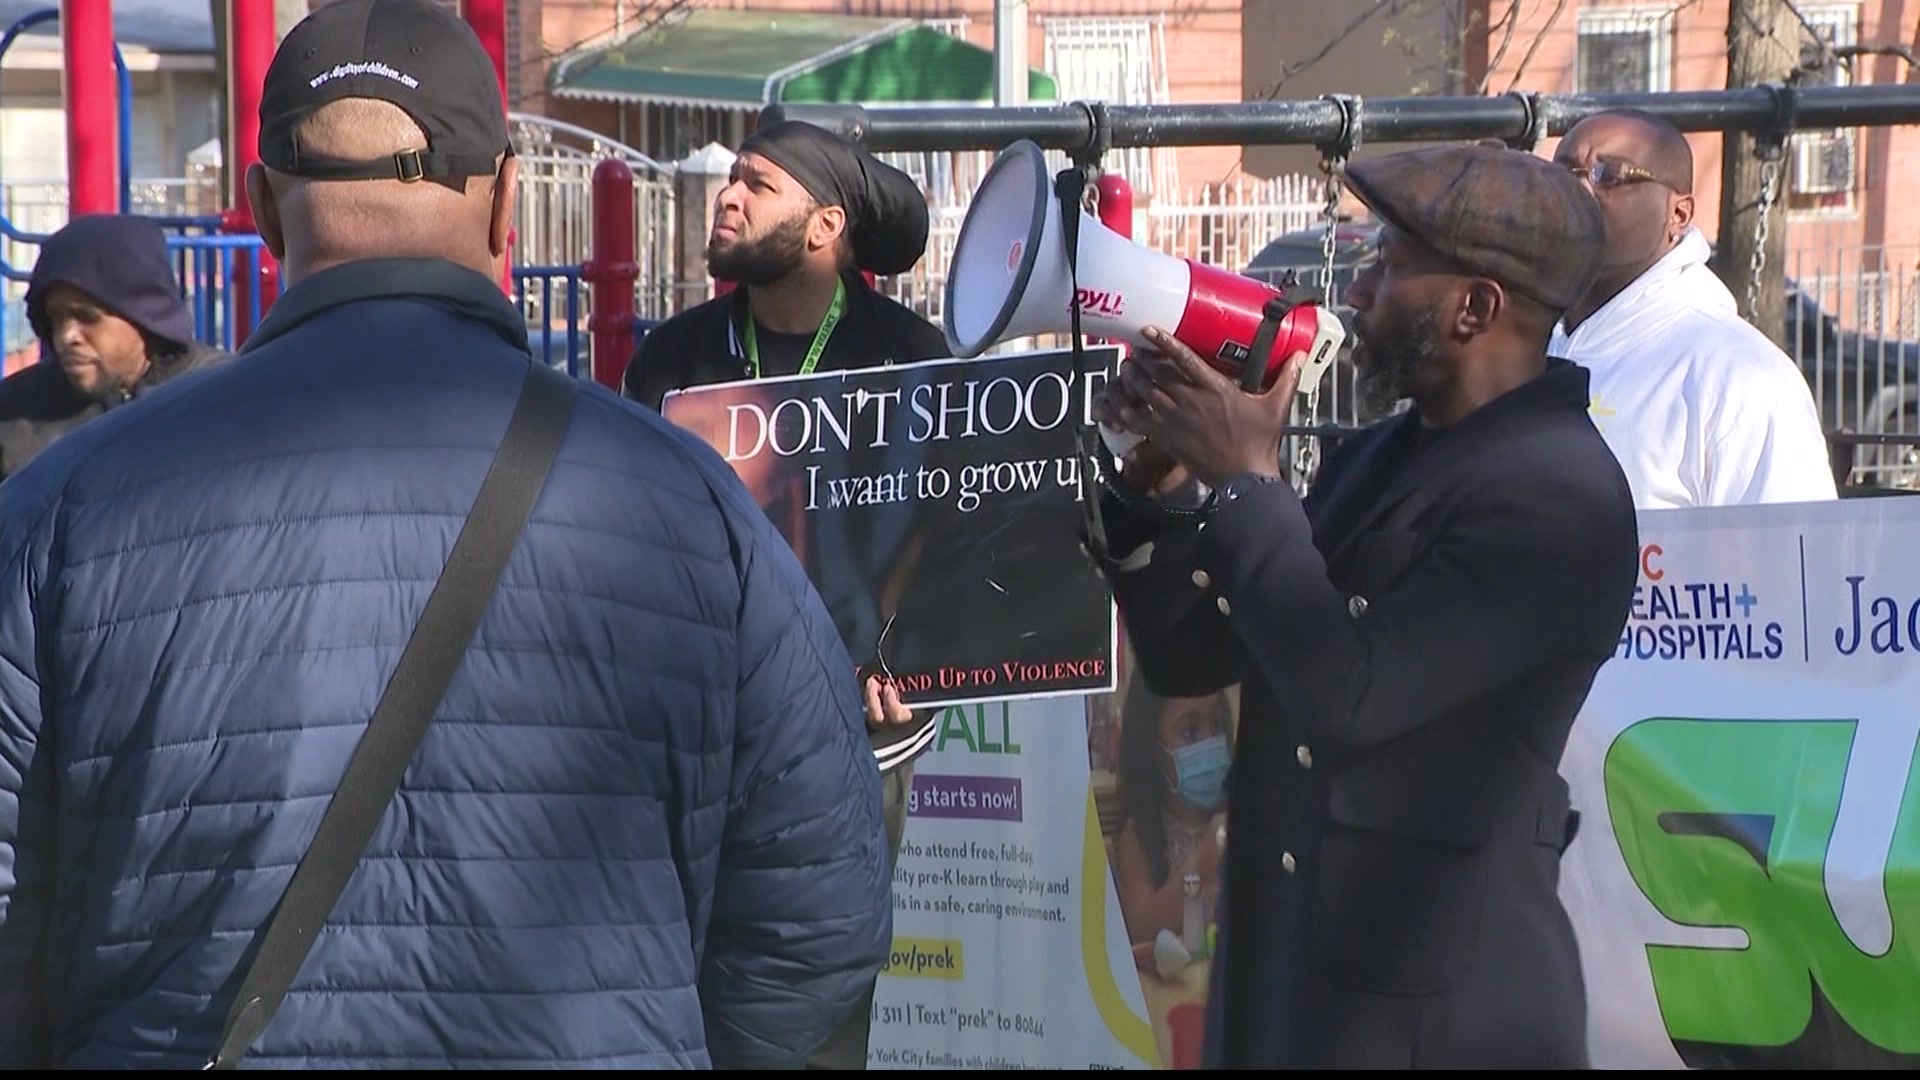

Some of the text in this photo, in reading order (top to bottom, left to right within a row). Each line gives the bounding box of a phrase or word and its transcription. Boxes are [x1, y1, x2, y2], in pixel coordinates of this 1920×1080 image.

[725, 388, 901, 462] DON'T
[805, 465, 821, 510] I
[827, 467, 909, 509] want
[916, 464, 950, 499] to
[957, 459, 1048, 512] grow
[1630, 582, 1757, 620] EALTH+
[938, 668, 966, 688] UP
[971, 668, 996, 686] TO
[1003, 659, 1105, 683] VIOLENCE
[936, 701, 1022, 754] ALL
[923, 788, 977, 808] starts
[982, 788, 1018, 809] now!
[925, 841, 967, 859] attend
[971, 842, 999, 862] free,
[892, 867, 914, 887] lity
[918, 868, 953, 888] pre-K
[956, 868, 987, 887] learn
[990, 870, 1027, 894] through
[1047, 877, 1069, 894] and
[910, 895, 921, 911] in
[924, 901, 931, 912] a
[934, 896, 965, 914] safe,
[968, 898, 1003, 920] caring
[1005, 902, 1066, 922] environment.
[883, 1006, 902, 1025] 311
[915, 1005, 946, 1026] Text
[997, 1013, 1011, 1031] to
[876, 1048, 898, 1063] York
[902, 1050, 922, 1068] City
[926, 1051, 963, 1067] families
